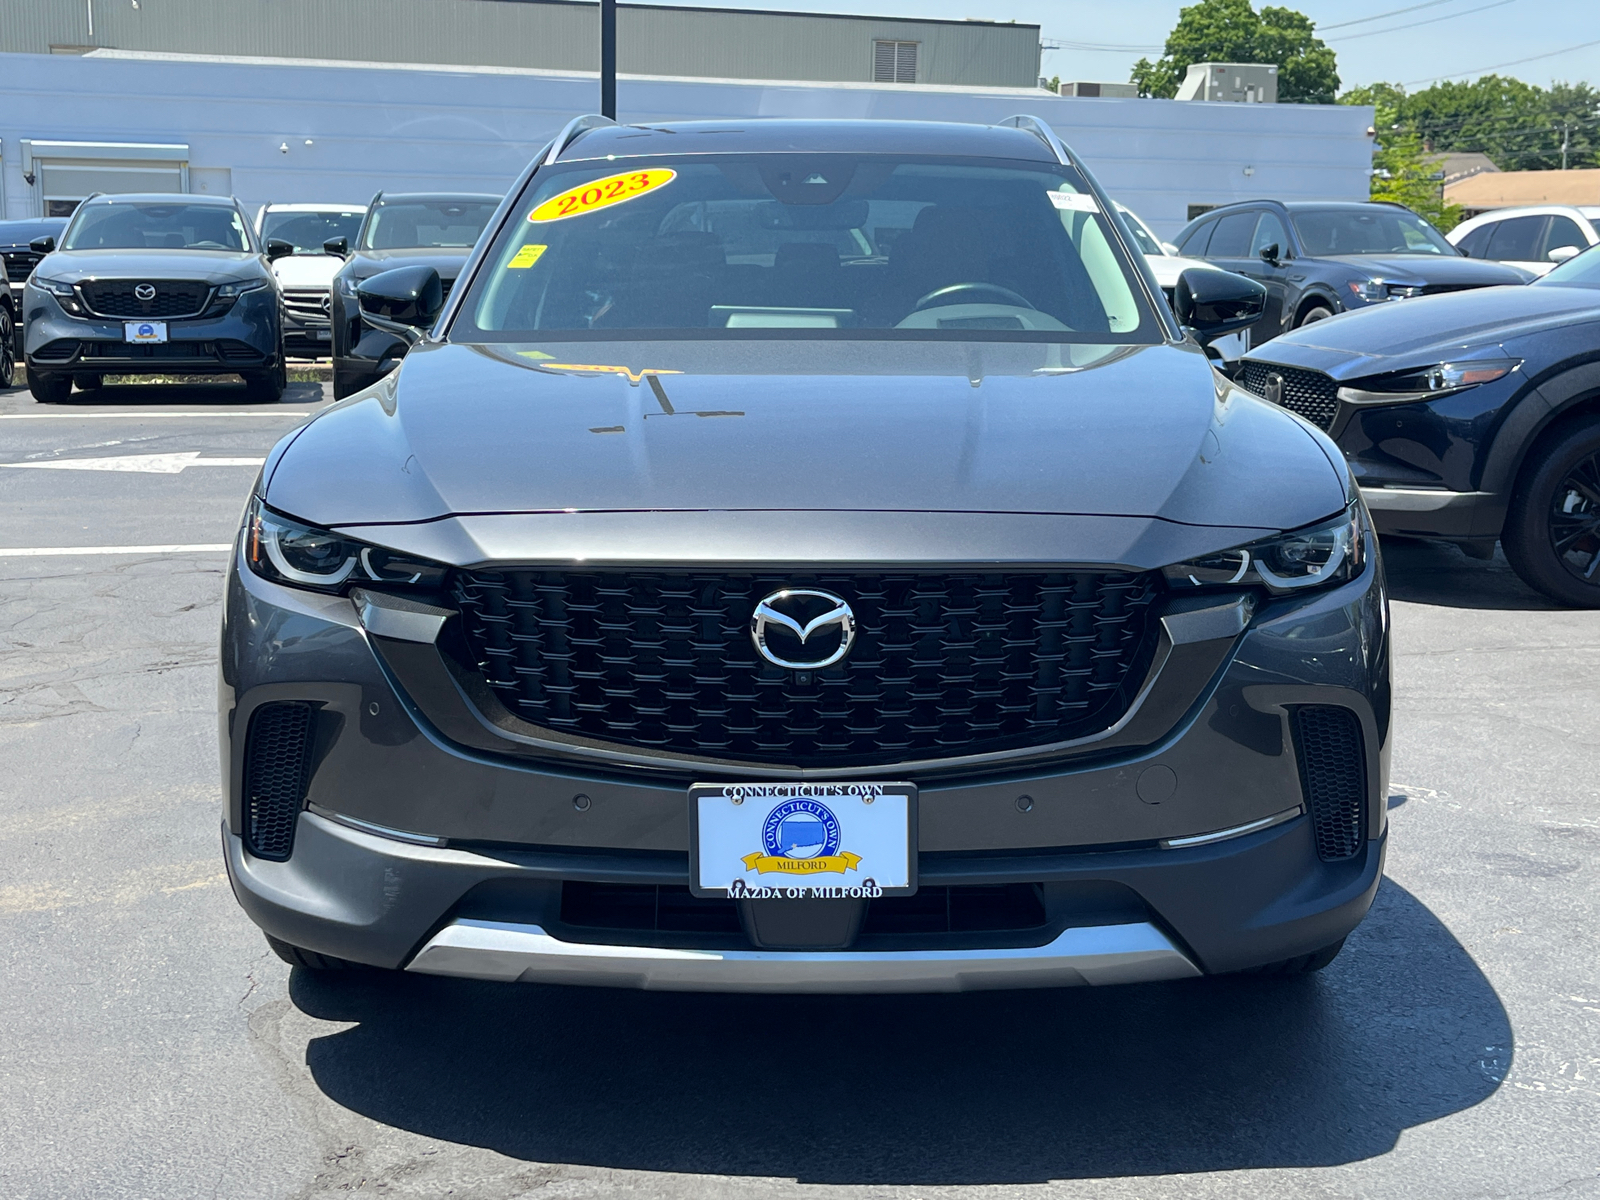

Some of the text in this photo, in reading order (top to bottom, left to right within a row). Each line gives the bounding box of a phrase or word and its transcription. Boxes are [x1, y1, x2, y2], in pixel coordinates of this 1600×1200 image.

[557, 173, 650, 216] 2023
[722, 785, 883, 797] CONNECTICUT'S OWN
[765, 801, 838, 849] CONNECTICUT'S OWN
[776, 860, 828, 871] MILFORD
[726, 886, 883, 899] MAZDA OF MILFORD
